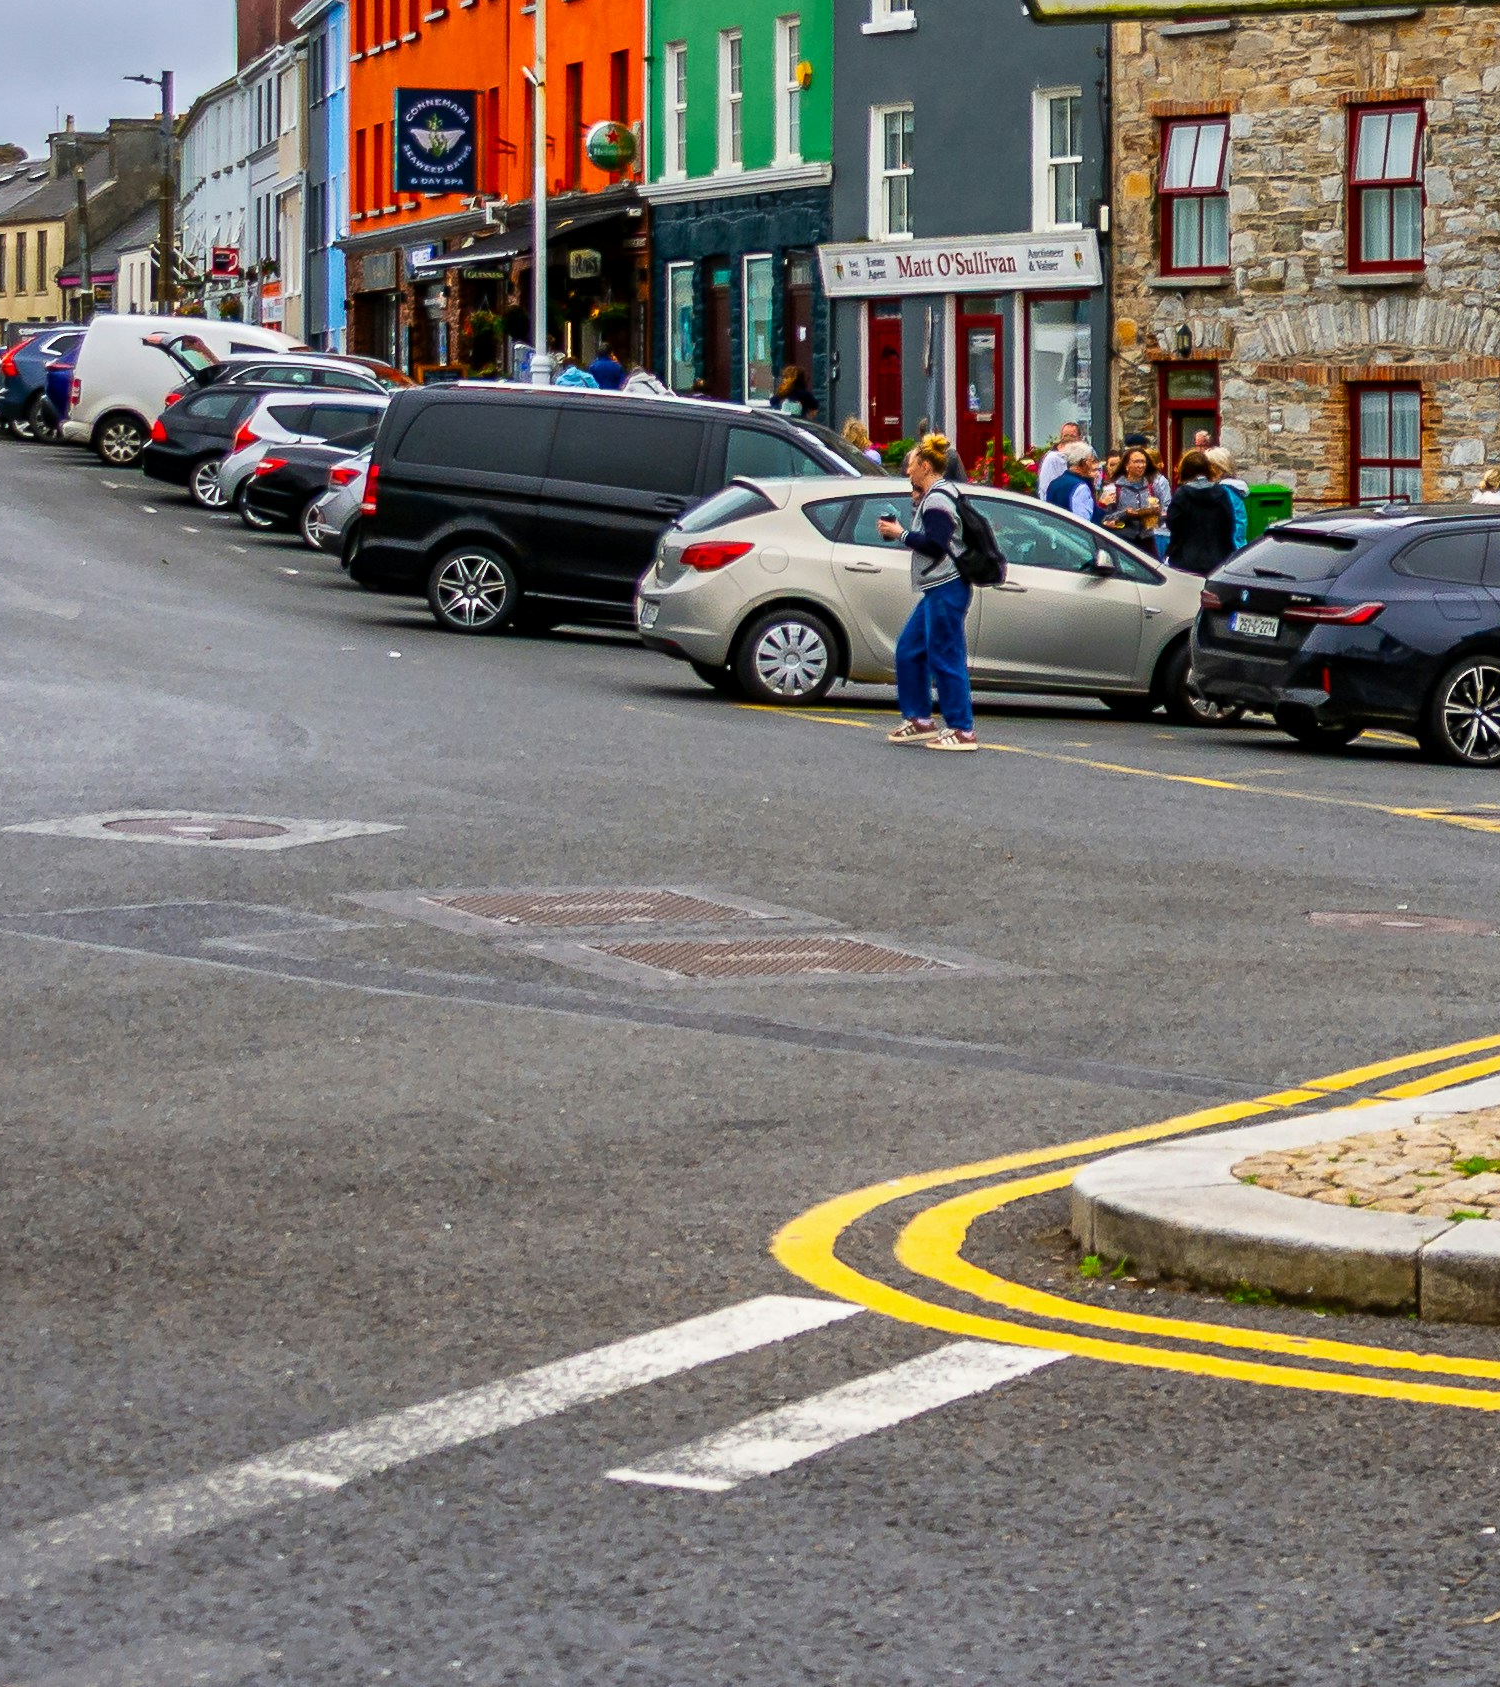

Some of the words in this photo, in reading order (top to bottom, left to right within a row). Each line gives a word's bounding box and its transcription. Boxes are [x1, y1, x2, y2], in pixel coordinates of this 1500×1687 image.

[405, 98, 470, 123] CONNEMARA
[403, 144, 445, 173] SEAWEED
[896, 256, 934, 278] Matt
[937, 252, 1017, 276] O'Sullivan
